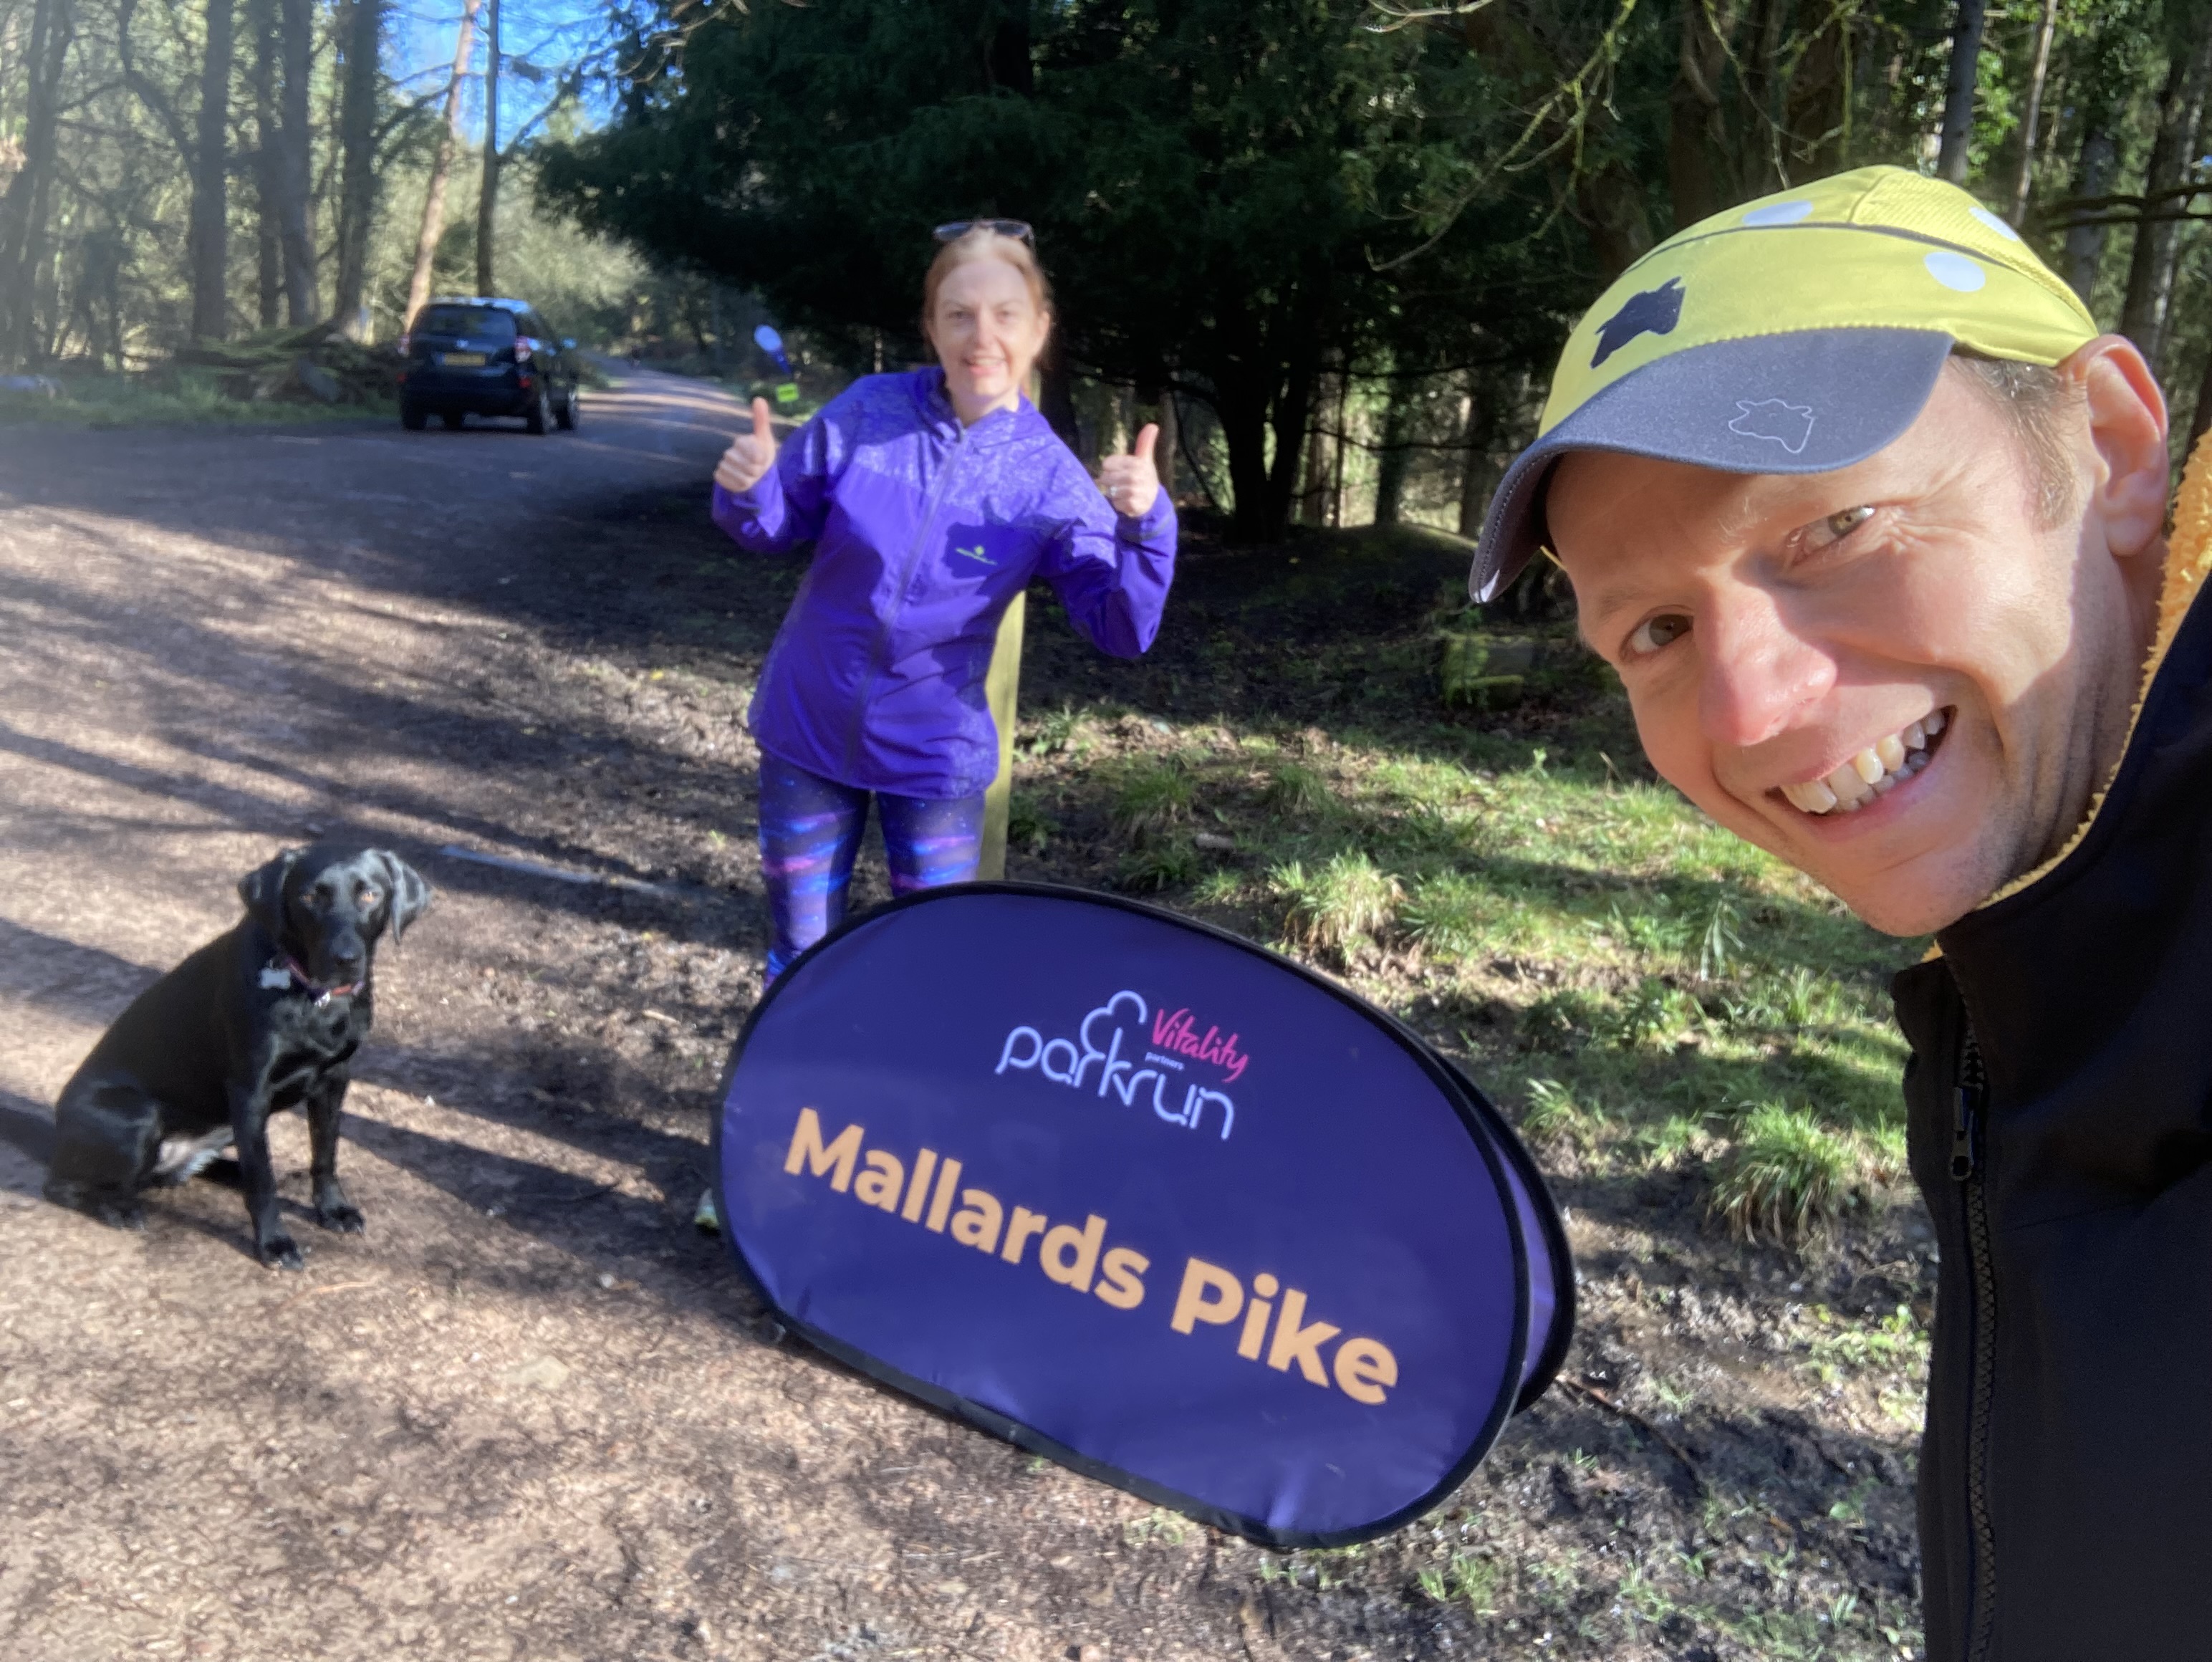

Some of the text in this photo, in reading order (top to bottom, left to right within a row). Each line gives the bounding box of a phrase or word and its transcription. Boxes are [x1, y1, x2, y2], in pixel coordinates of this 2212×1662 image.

[995, 990, 1234, 1140] parkrun
[1151, 1008, 1248, 1083] Vitality
[784, 1108, 1399, 1405] Mallards Pike
